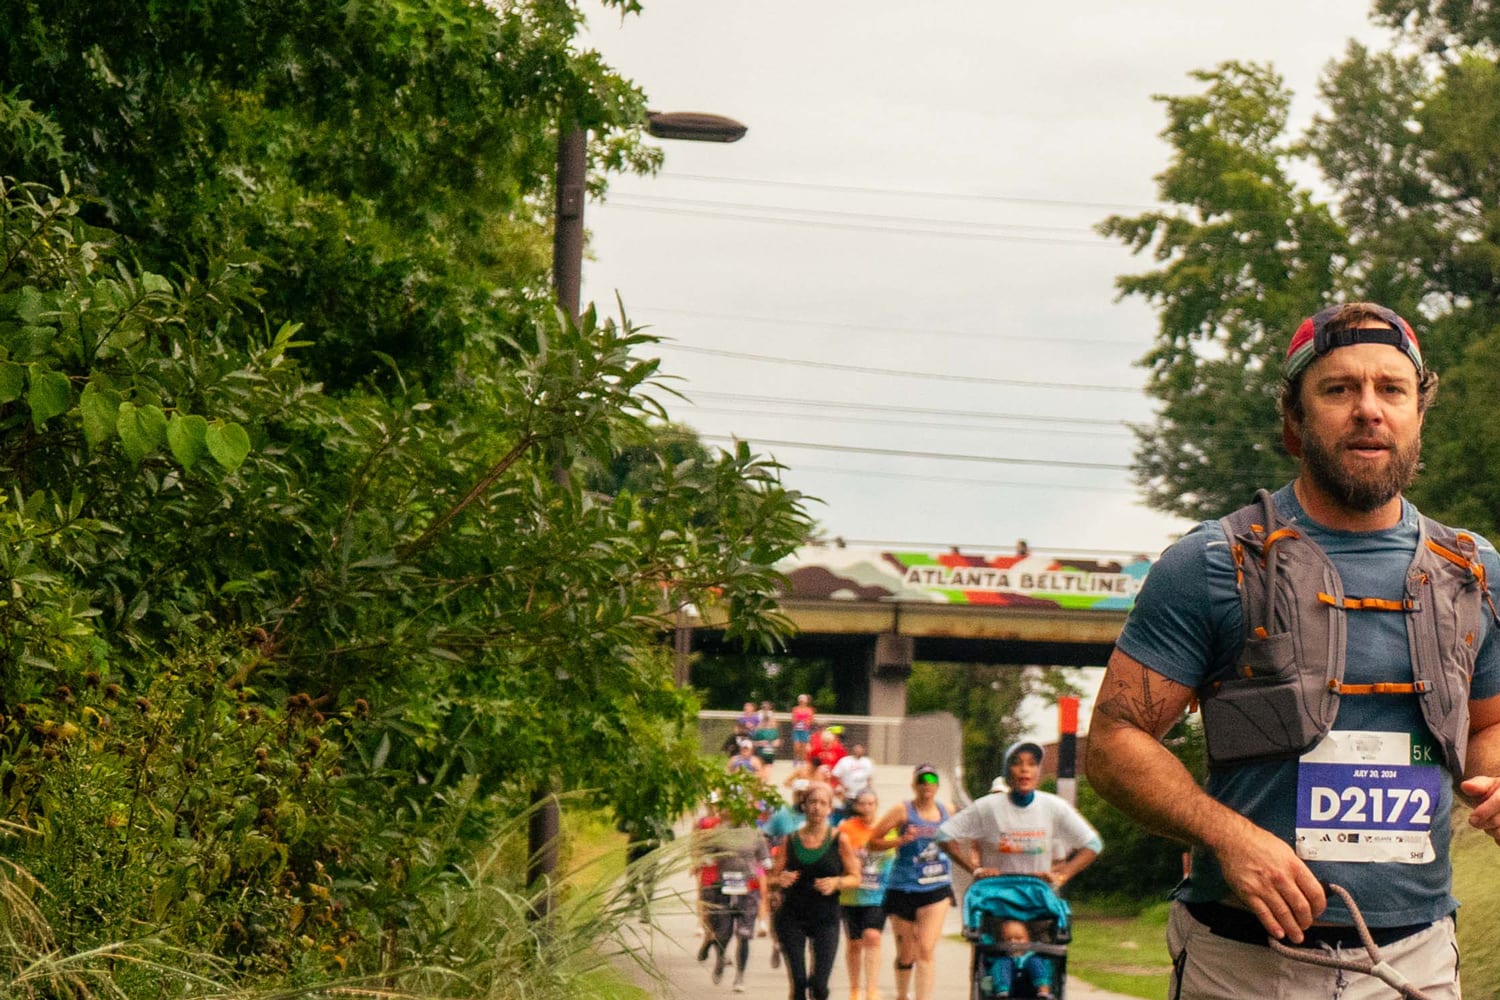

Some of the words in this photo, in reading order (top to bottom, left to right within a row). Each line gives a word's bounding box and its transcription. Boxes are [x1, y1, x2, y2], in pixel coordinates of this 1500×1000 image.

[908, 569, 1010, 588] ATLANTA
[1019, 573, 1128, 594] BELTLINE
[1413, 744, 1432, 761] 5K
[1353, 769, 1369, 778] JULY
[1381, 770, 1397, 778] 2024
[1310, 786, 1432, 824] D2172
